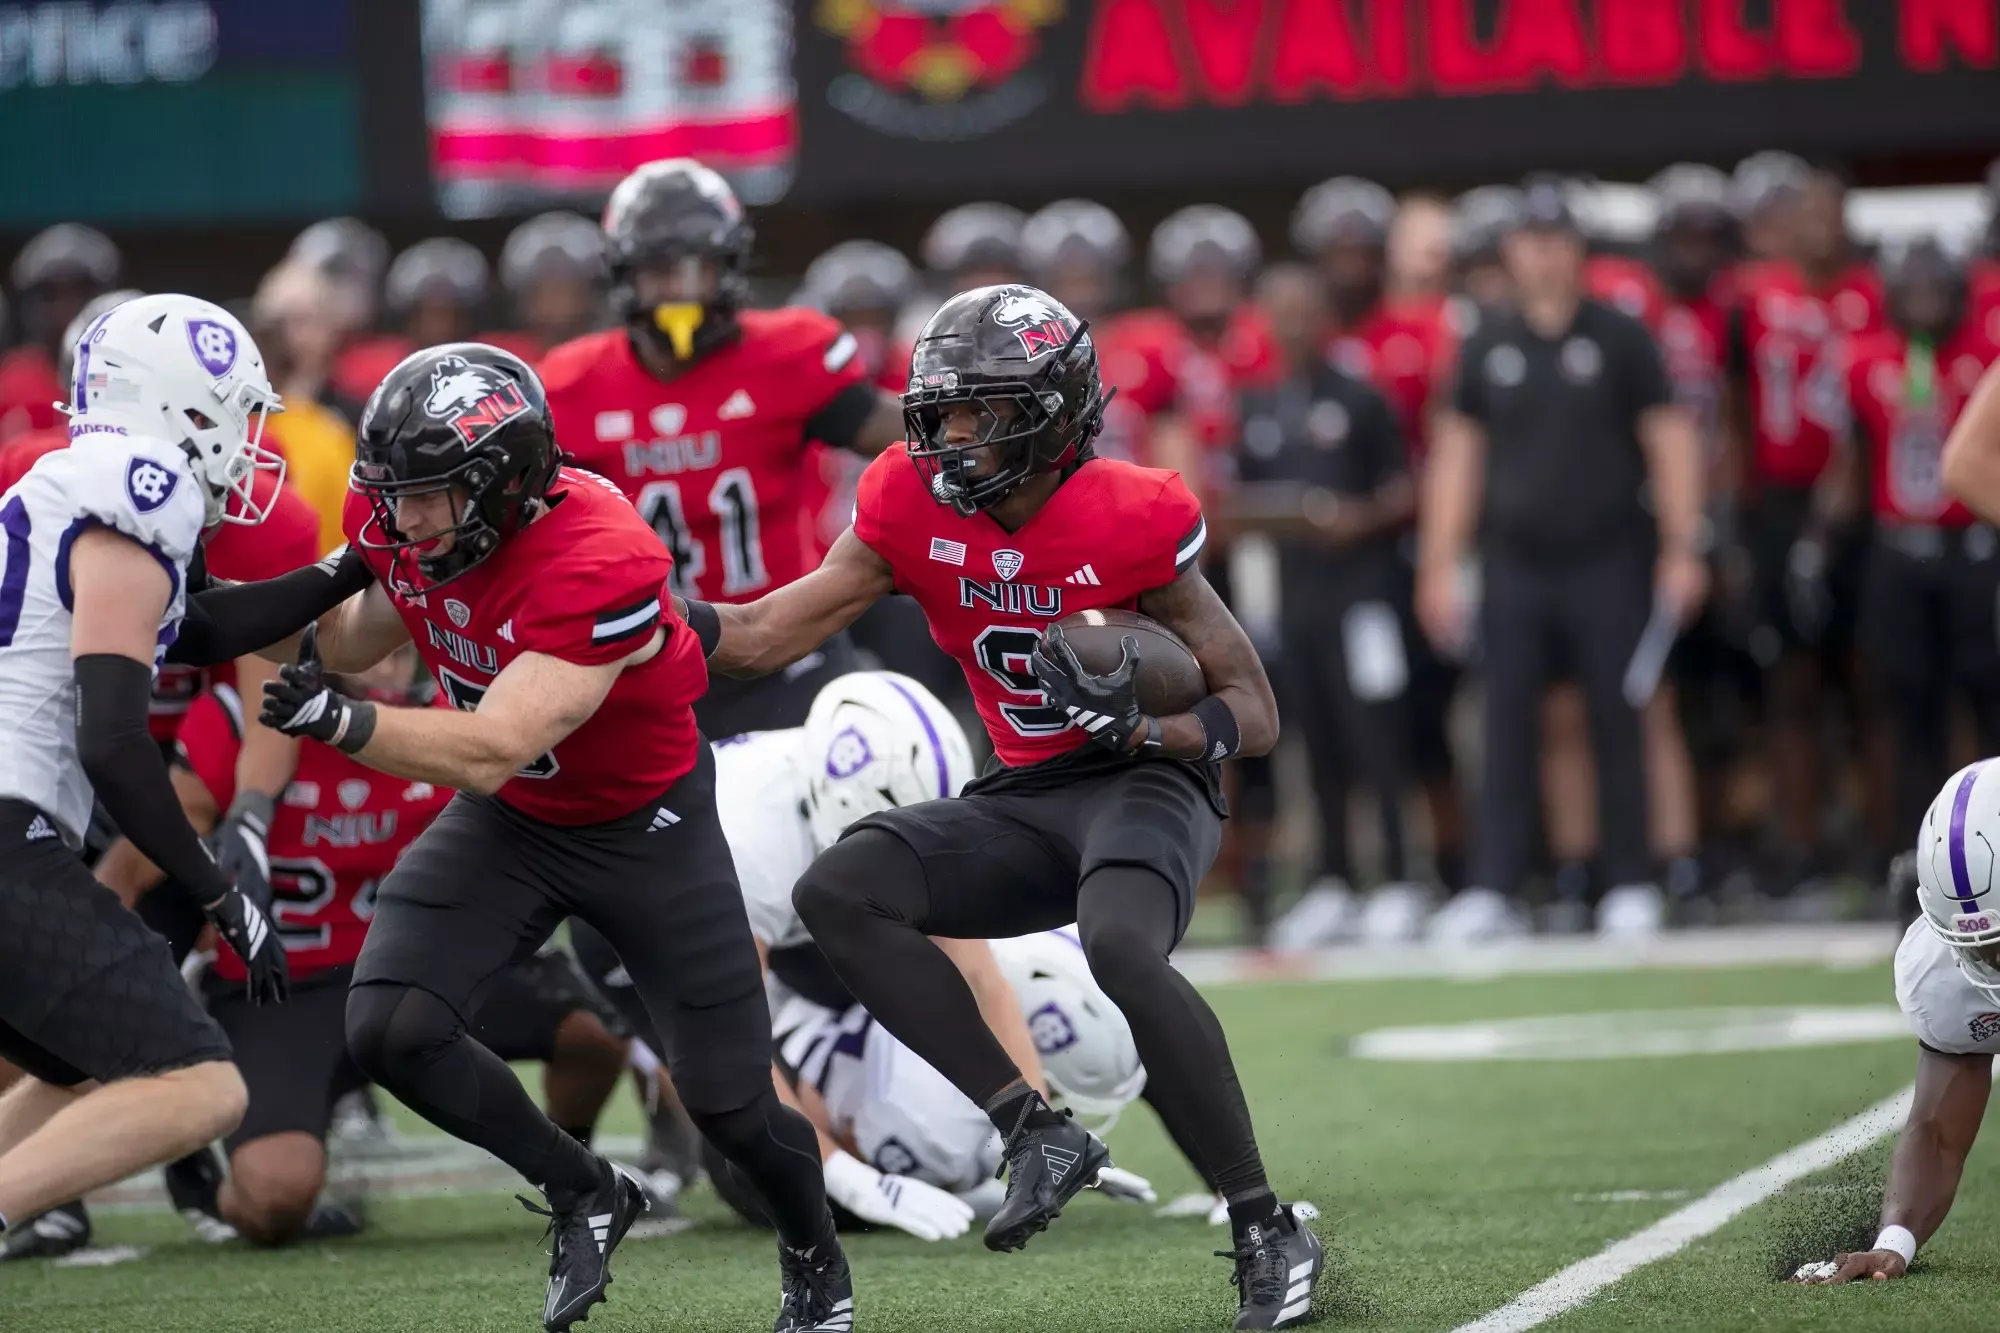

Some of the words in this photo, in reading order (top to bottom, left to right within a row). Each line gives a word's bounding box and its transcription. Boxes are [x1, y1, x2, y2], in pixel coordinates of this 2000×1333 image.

[455, 384, 524, 444] NIU
[621, 429, 722, 477] NIU
[636, 466, 771, 601] 41
[958, 577, 1063, 616] NIU
[424, 618, 499, 676] NIU
[972, 624, 1075, 737] 9
[302, 809, 399, 848] NIU
[1957, 916, 1991, 932] 508
